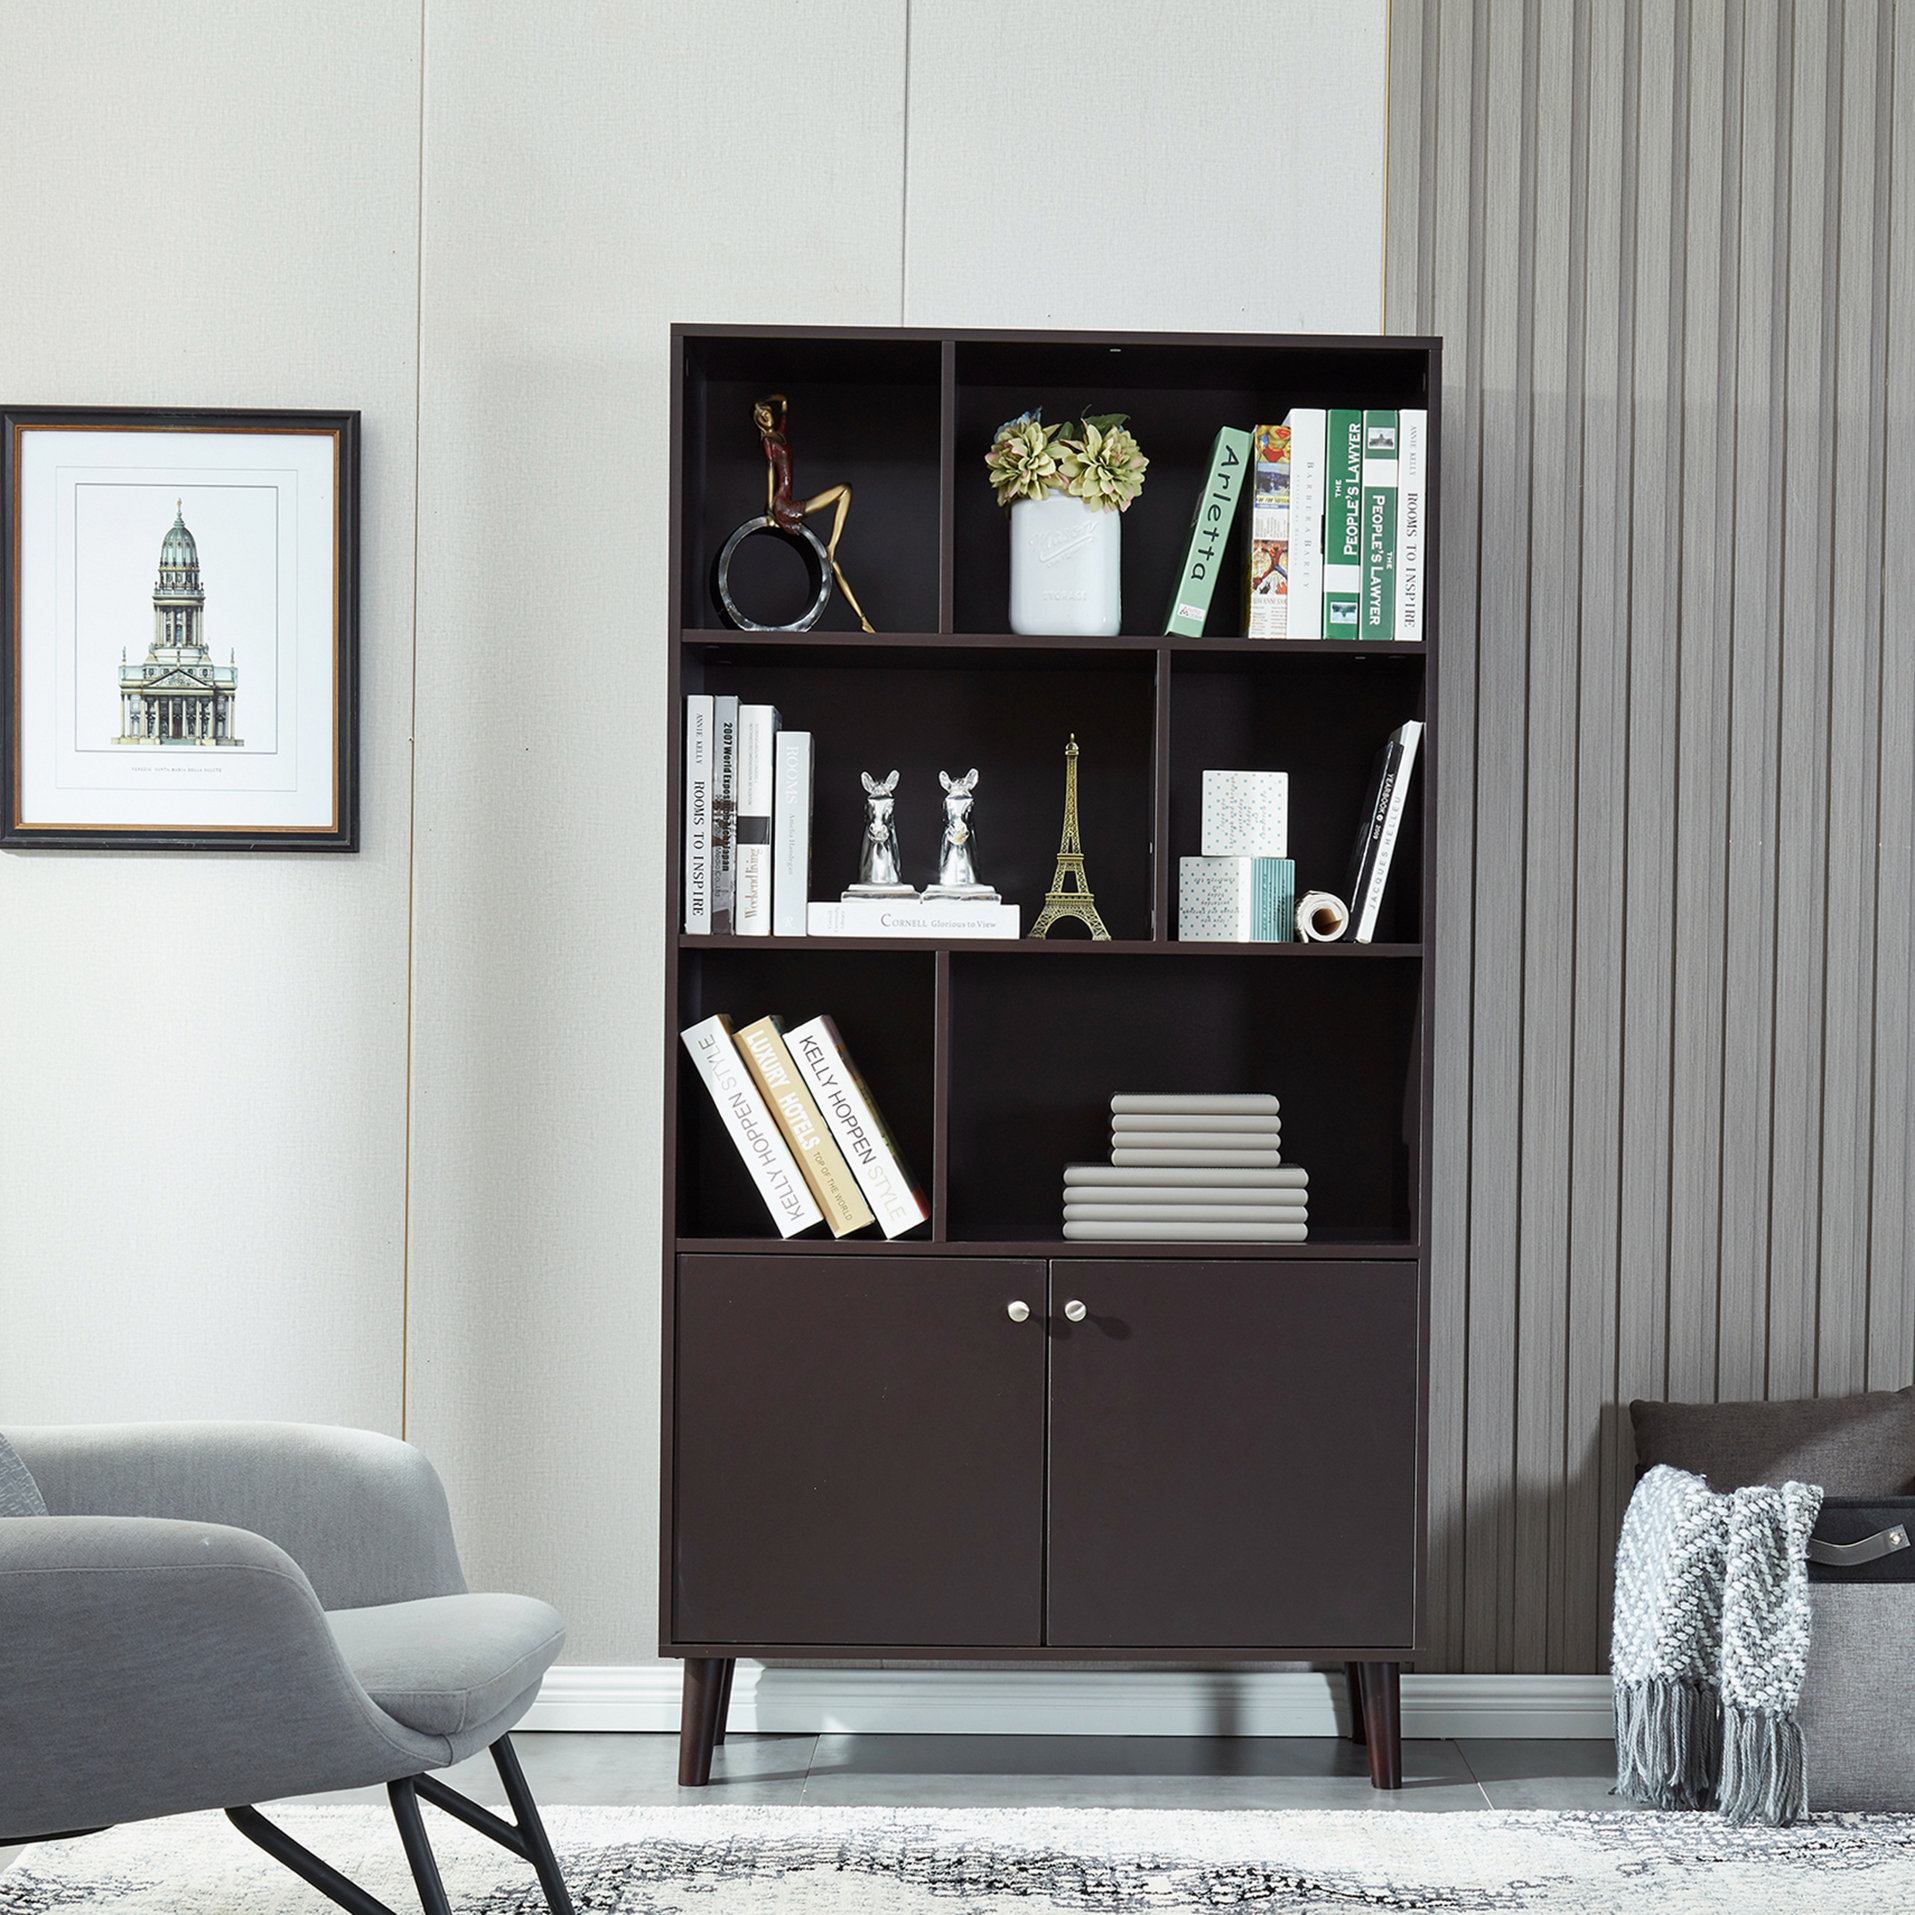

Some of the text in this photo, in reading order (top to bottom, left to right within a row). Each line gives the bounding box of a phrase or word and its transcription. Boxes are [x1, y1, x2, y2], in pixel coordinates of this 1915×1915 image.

[1190, 445, 1239, 581] Arletta
[1334, 479, 1342, 498] THE
[1343, 423, 1361, 556] PEOPLE'S LAWYER
[1368, 495, 1386, 626] PEOPLE'S LAWYER
[1385, 551, 1393, 570] THE
[1404, 492, 1418, 628] ROOMS TO INSPIRE
[722, 722, 733, 745] 2007
[722, 747, 733, 772] World
[785, 745, 801, 805] ROOMS
[691, 780, 706, 916] ROOMS TO INSPIRE
[1378, 772, 1395, 815] YEARBOOK
[1369, 795, 1401, 910] JACQUES HELLEU
[880, 913, 997, 929] CORNELL Glorious to View
[698, 1033, 805, 1222] KELLY HOPPEN STYLE
[745, 1029, 821, 1151] LUXURY HOTELS
[799, 1035, 906, 1222] KELLY HOPPEN STYLE
[813, 1151, 853, 1221] TOP OF THE WORLD
